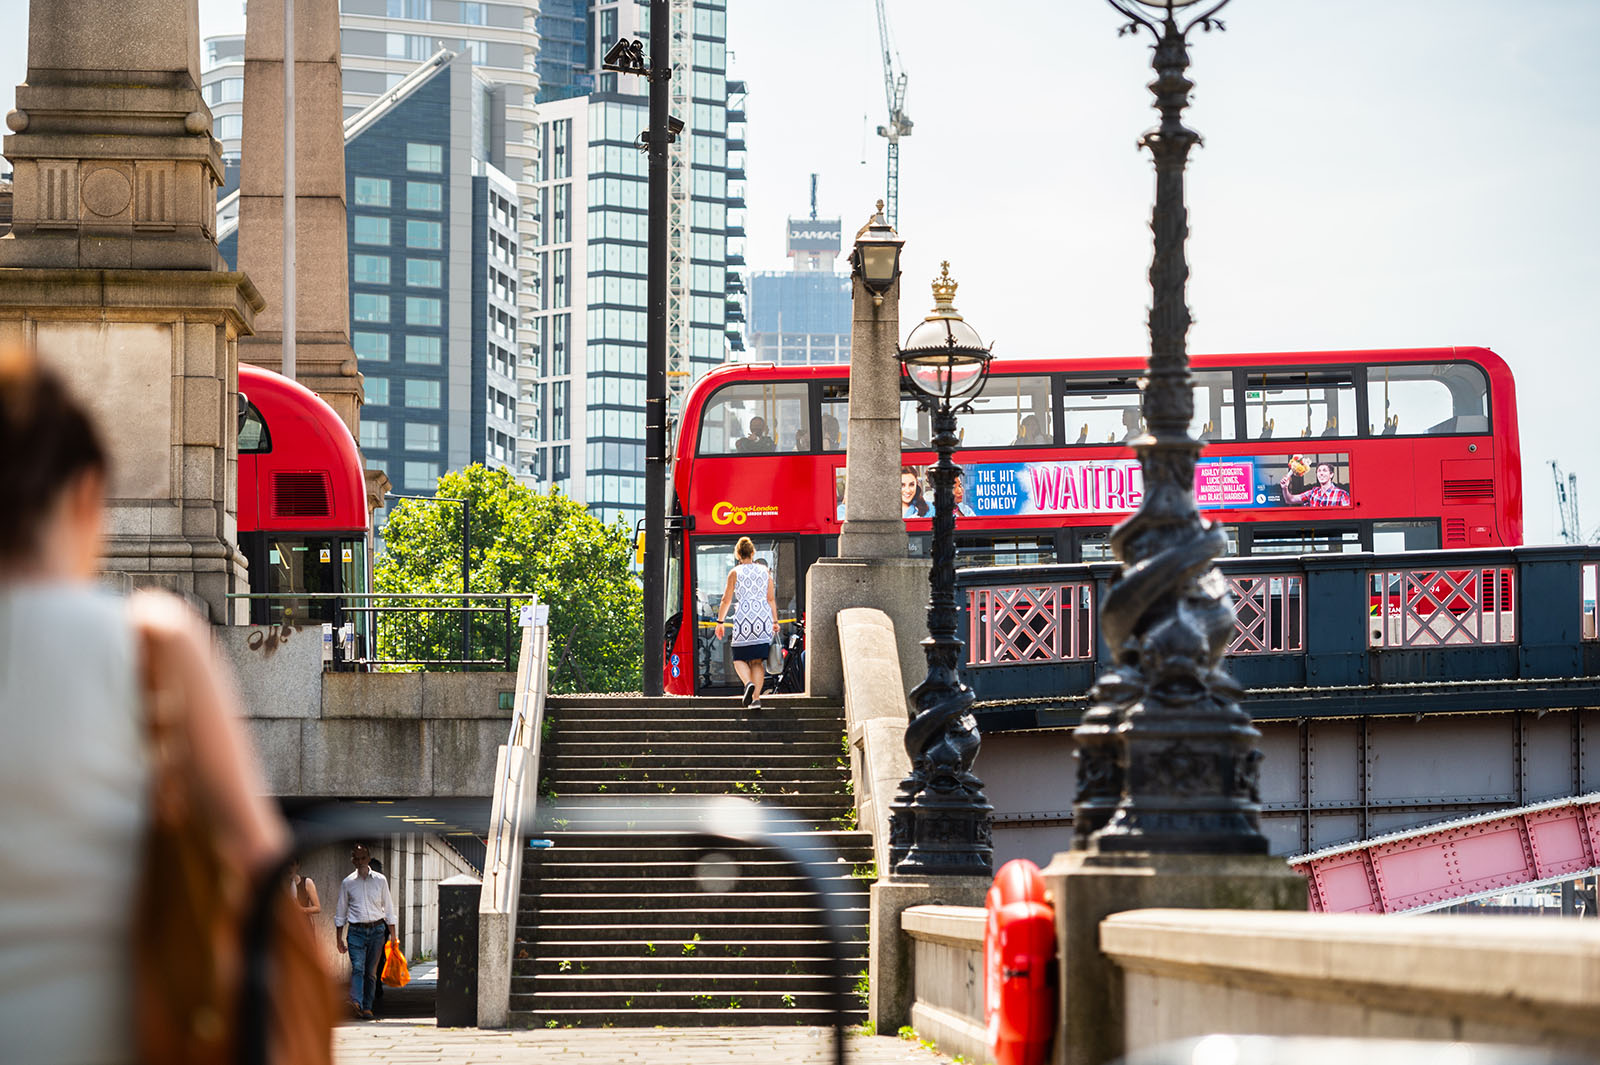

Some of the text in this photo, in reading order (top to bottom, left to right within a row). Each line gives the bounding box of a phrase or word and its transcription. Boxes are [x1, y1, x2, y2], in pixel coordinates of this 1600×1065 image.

[978, 469, 1015, 482] THE HIT
[976, 483, 1018, 497] MUSICAL
[1028, 463, 1144, 511] WAITRE
[977, 496, 1017, 511] COMEDY
[712, 501, 746, 525] Go
